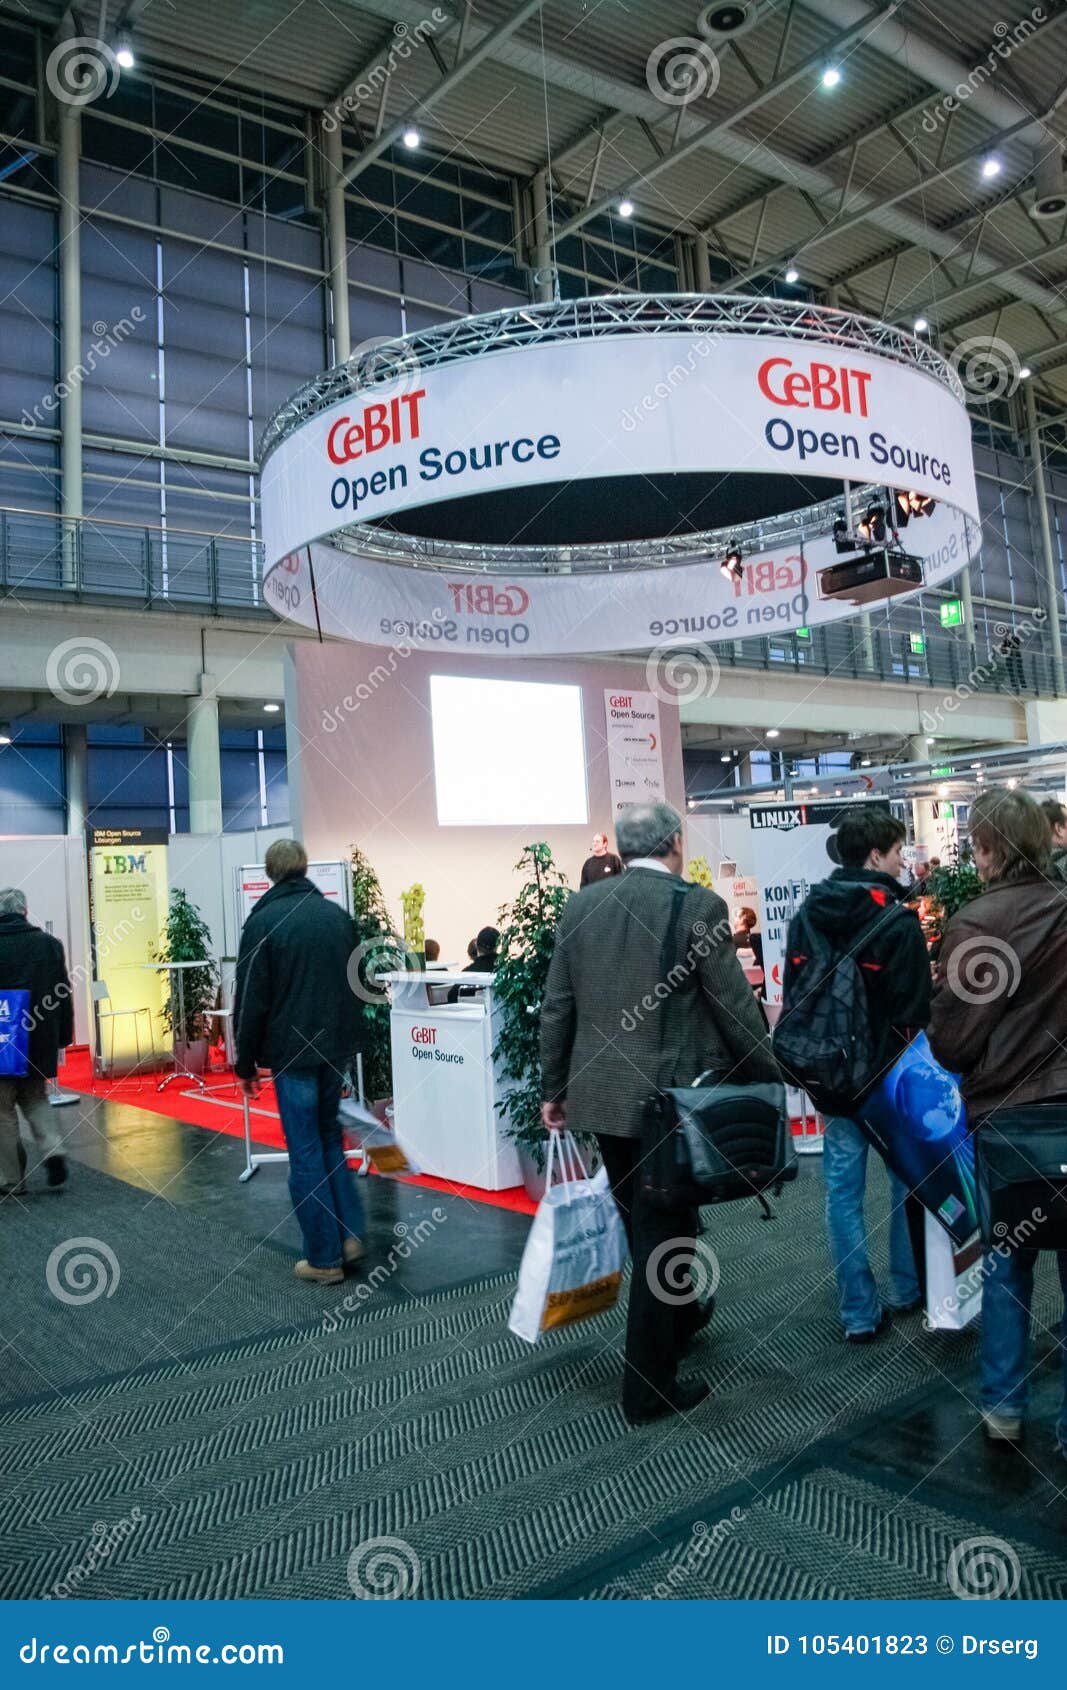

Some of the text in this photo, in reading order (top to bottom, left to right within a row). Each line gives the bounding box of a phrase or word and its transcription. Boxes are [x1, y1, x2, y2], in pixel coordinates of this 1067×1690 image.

[758, 357, 871, 417] CeBIT
[327, 389, 426, 465] CeBIT
[765, 418, 951, 486] Open Source
[331, 434, 561, 510] Open Source
[609, 695, 633, 709] CeBIT
[610, 709, 656, 720] Open Source
[752, 810, 801, 828] LINUX
[103, 854, 147, 875] IBM
[411, 1025, 437, 1045] CeBIT
[412, 1046, 464, 1064] Open Source
